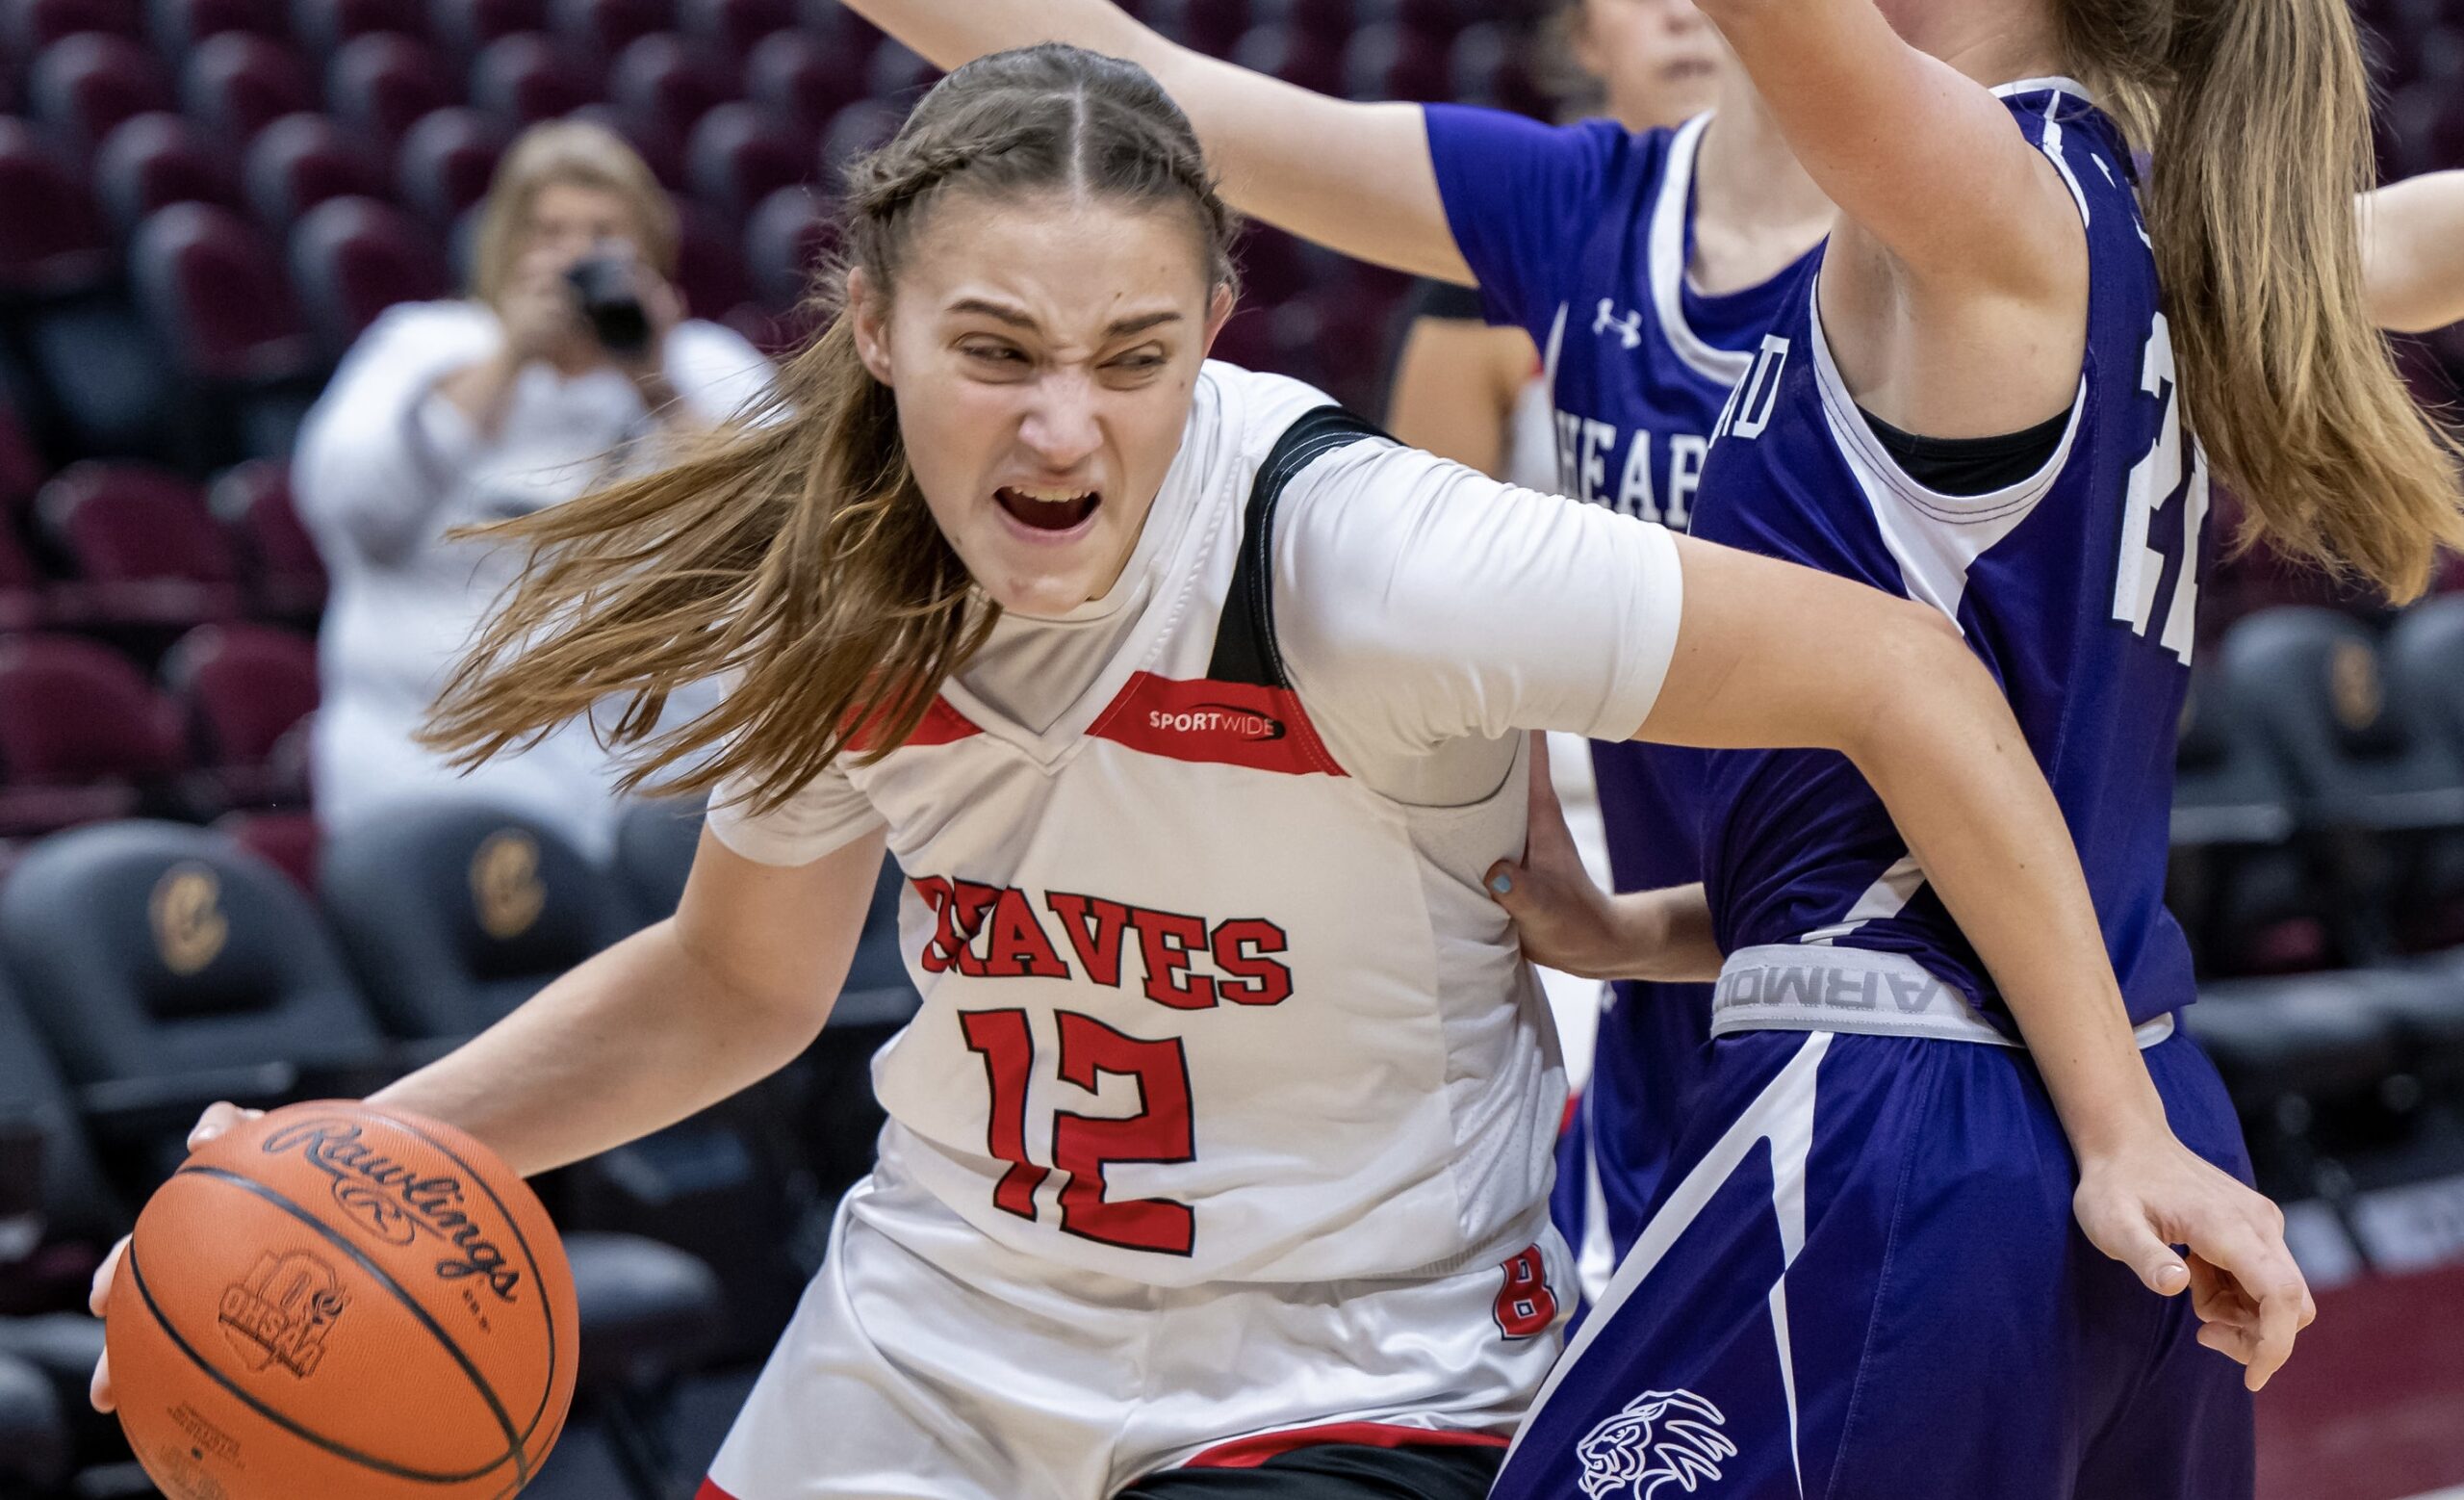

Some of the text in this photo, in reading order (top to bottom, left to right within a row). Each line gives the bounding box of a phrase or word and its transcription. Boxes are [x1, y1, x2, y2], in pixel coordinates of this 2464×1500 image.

[1149, 711, 1276, 737] SPORTWIDE
[958, 1007, 1196, 1257] 12
[262, 1117, 520, 1303] Rawlings
[1493, 1242, 1559, 1341] B
